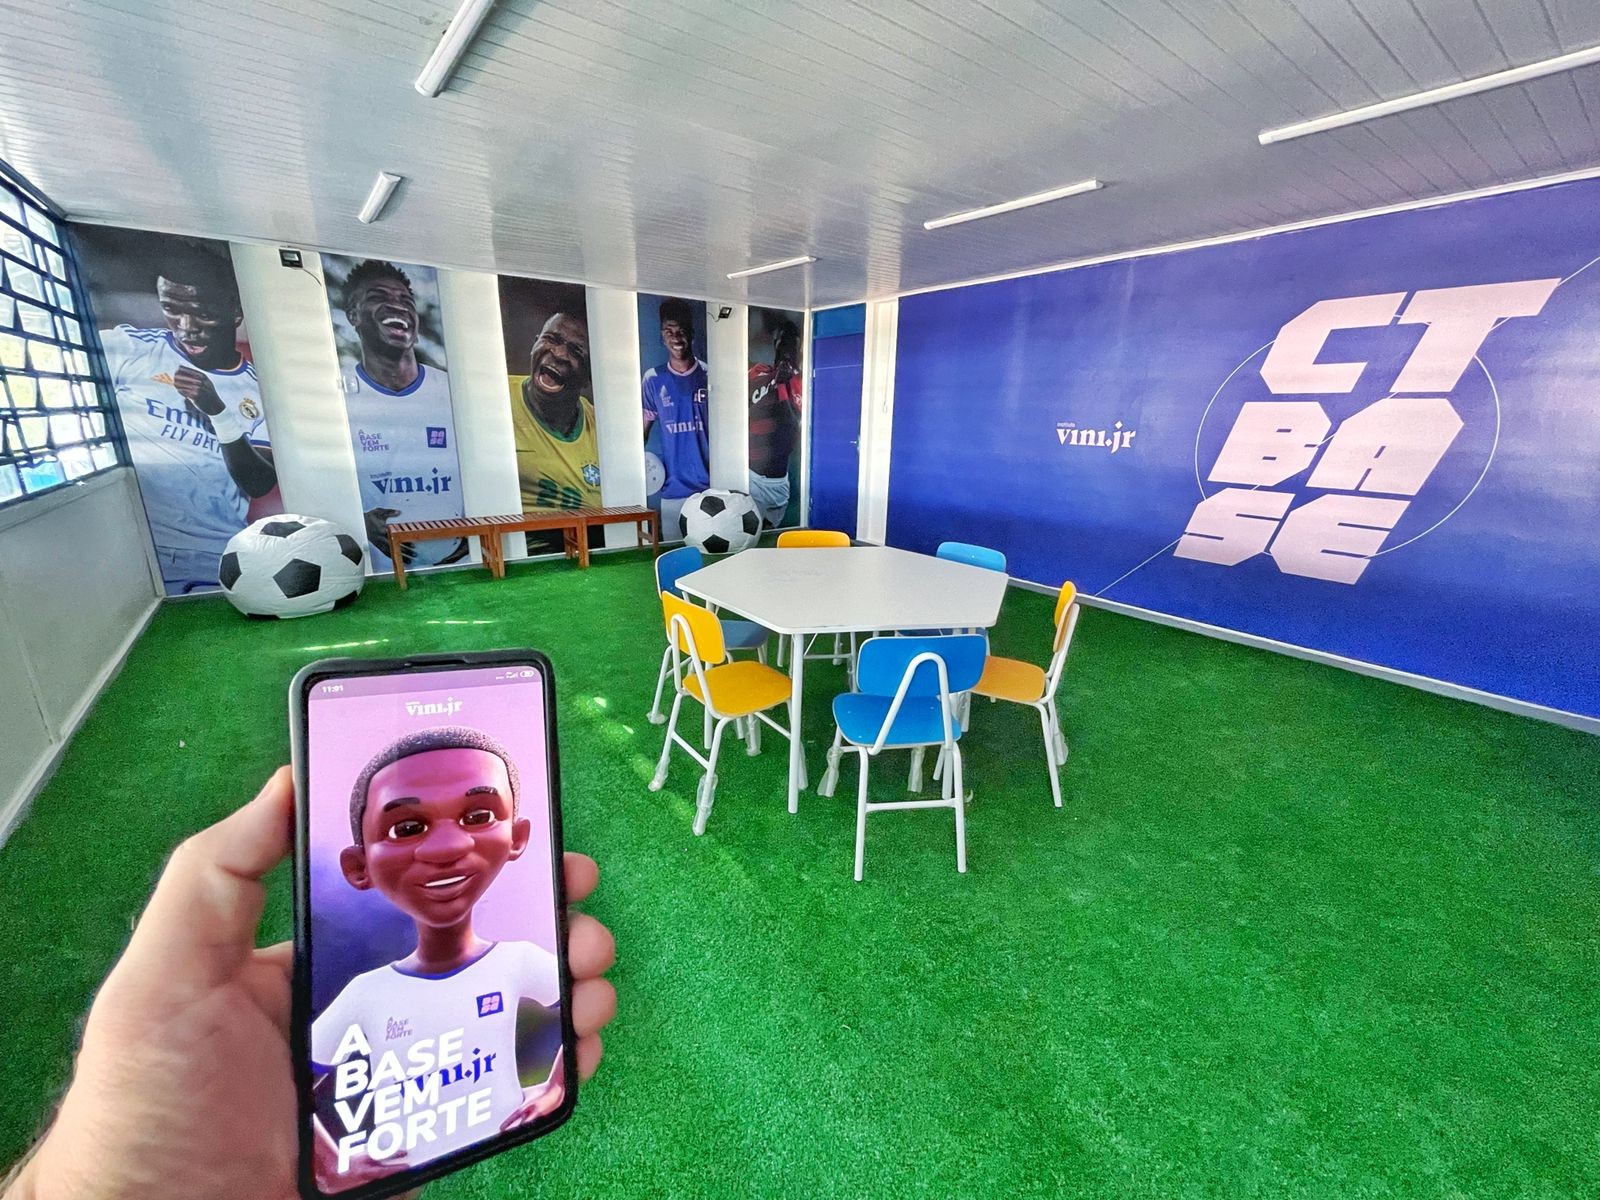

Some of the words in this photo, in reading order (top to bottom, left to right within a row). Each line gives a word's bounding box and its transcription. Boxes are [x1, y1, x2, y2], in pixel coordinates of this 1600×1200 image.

[1260, 278, 1561, 394] CT
[160, 424, 189, 441] FLY
[359, 433, 382, 441] BASE
[363, 444, 390, 452] FORTE
[1056, 421, 1136, 454] vini.jr
[1207, 398, 1464, 496] BA
[371, 467, 451, 494] vini.jr
[1173, 487, 1411, 585] SE
[405, 696, 463, 717] vini.jr
[330, 1023, 373, 1066] A
[335, 1027, 465, 1100] BASE
[333, 1070, 441, 1133] VEM
[337, 1087, 493, 1175] FORTE
